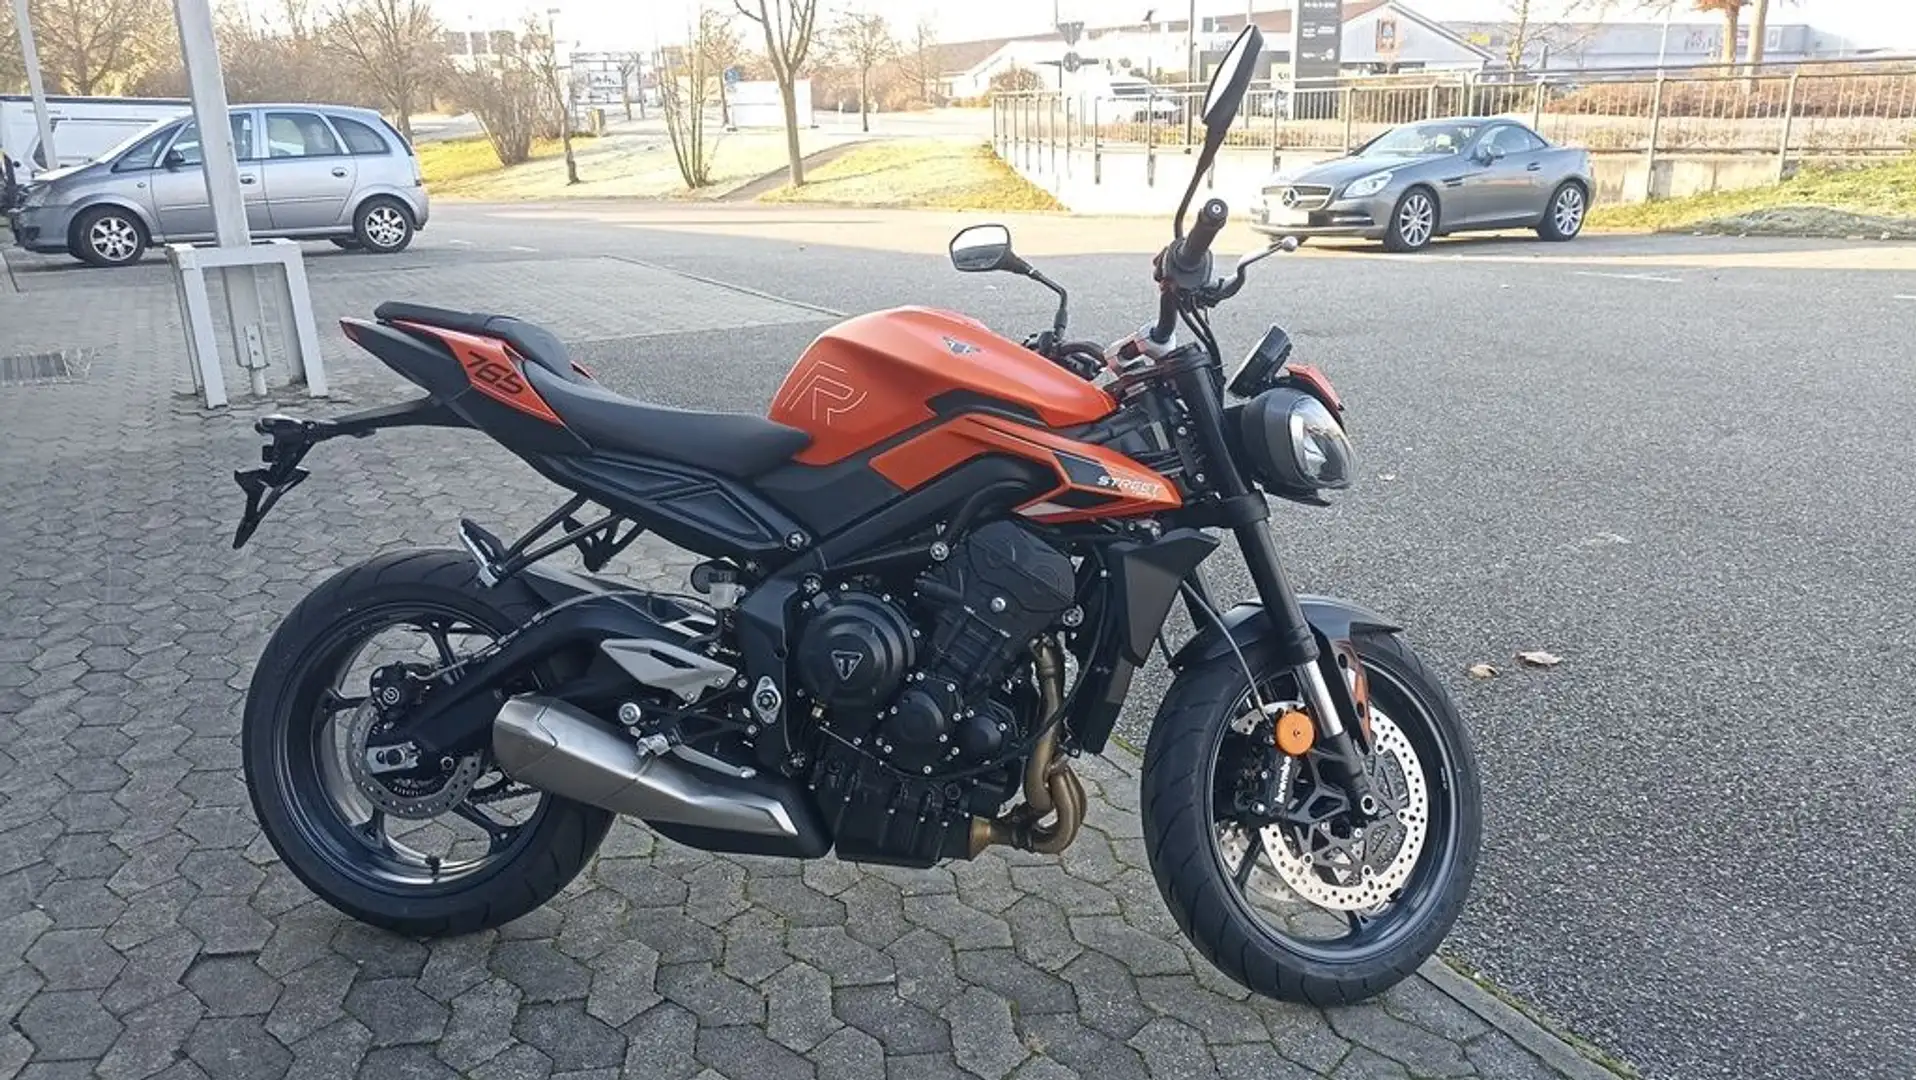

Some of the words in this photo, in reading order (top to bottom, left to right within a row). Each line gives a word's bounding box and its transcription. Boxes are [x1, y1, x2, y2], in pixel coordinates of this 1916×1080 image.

[467, 350, 523, 394] 765
[1097, 475, 1161, 492] STREET
[1274, 756, 1291, 803] brembo
